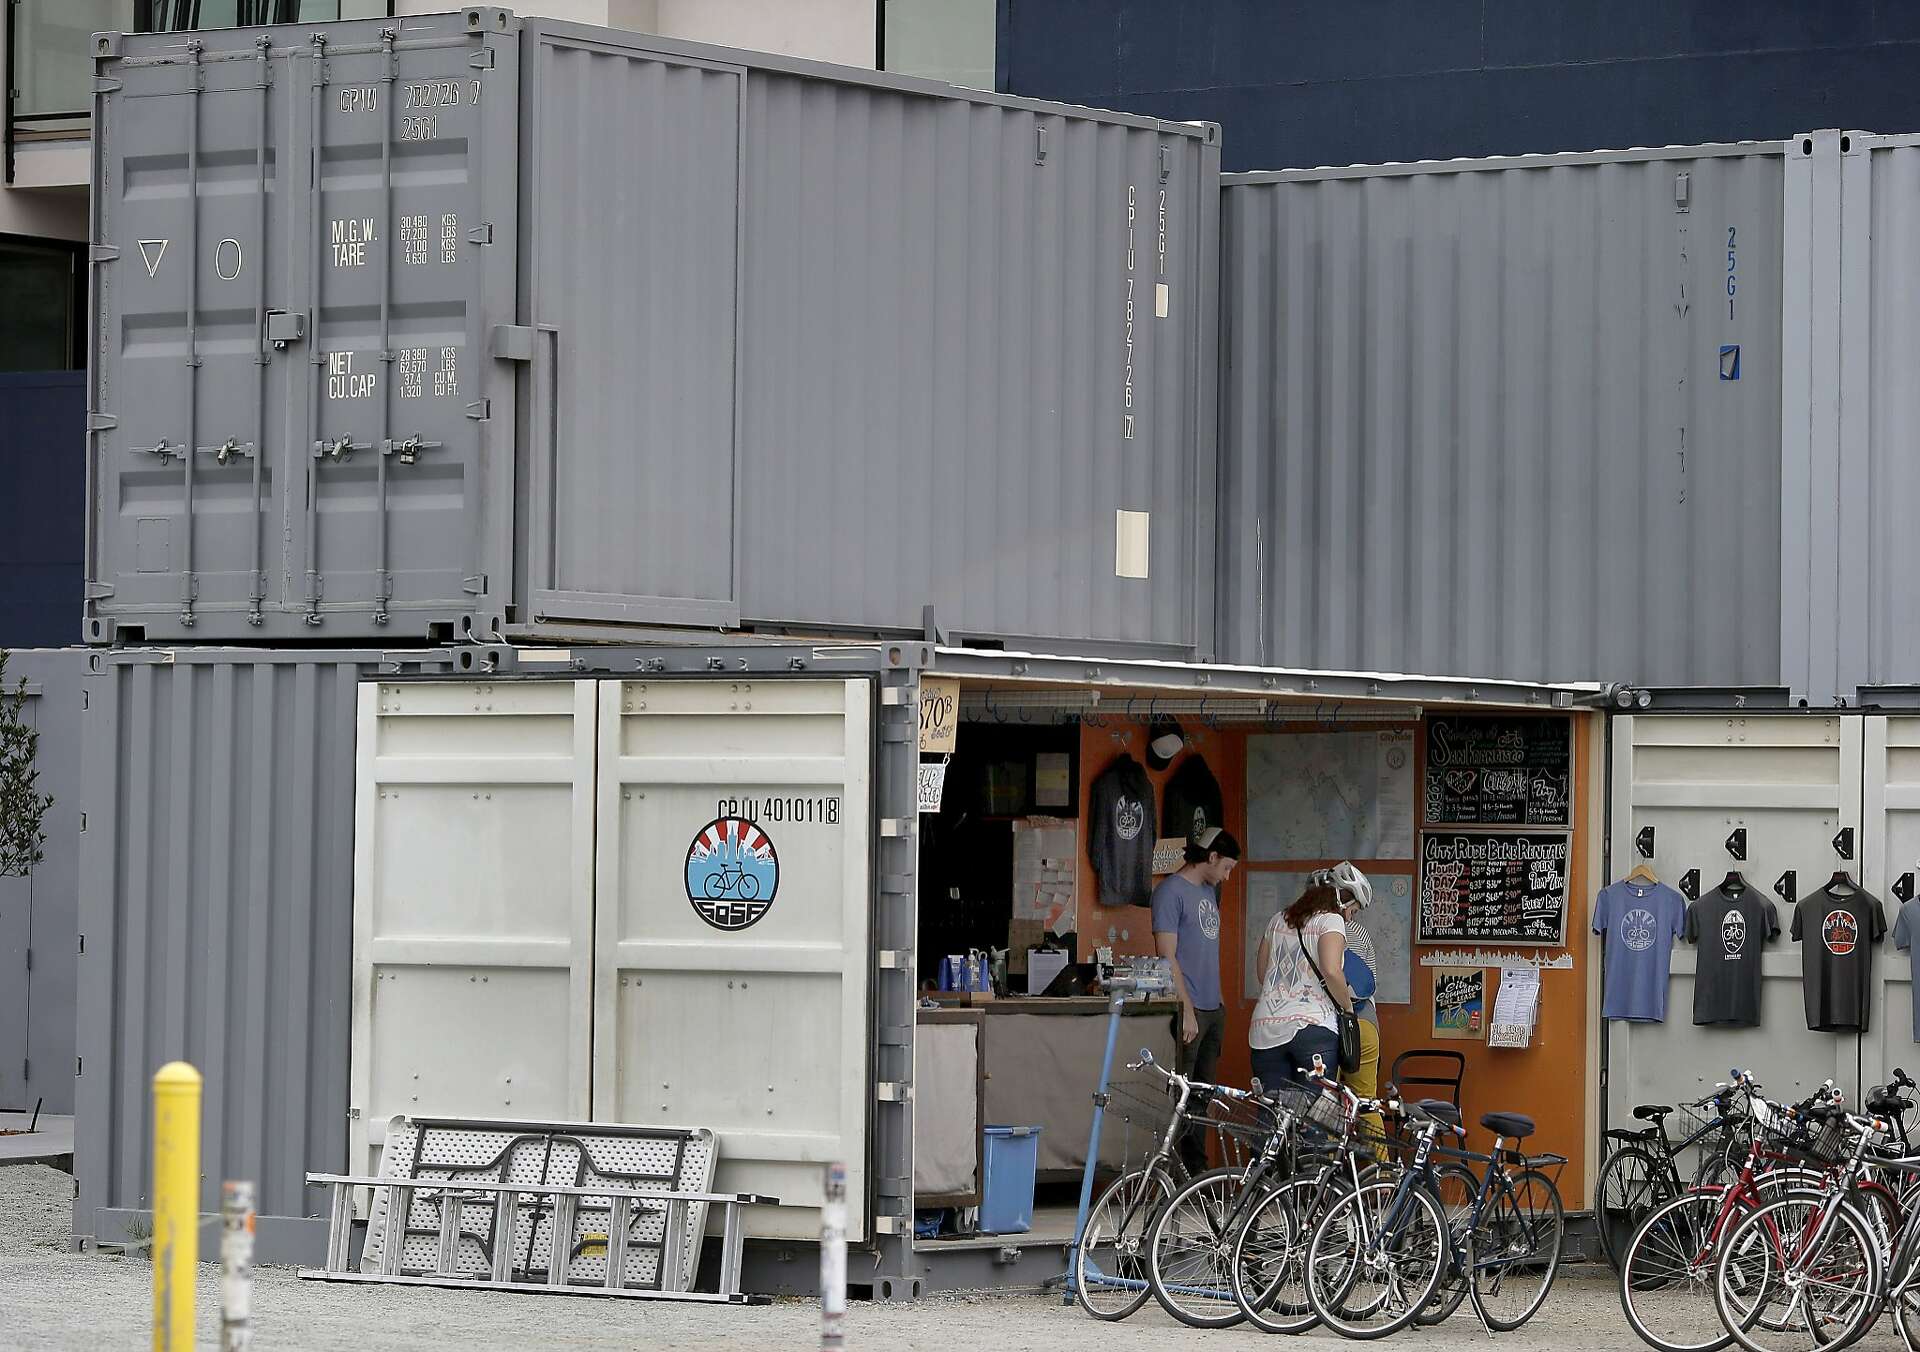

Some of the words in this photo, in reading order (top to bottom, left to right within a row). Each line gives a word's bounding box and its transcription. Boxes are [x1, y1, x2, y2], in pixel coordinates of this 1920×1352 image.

[401, 115, 438, 140] 25G1
[332, 218, 378, 243] M.G.W.
[441, 214, 457, 226] KGS
[441, 226, 457, 239] LBS
[332, 243, 366, 267] TARE
[441, 239, 457, 251] KGS
[441, 251, 457, 264] LBS
[329, 351, 353, 375] NET
[441, 347, 456, 359] KGS
[441, 359, 456, 371] LBS
[329, 374, 376, 399] CU.CAP
[1454, 837, 1487, 860] RIDE
[1488, 838, 1518, 861] BIKE
[1432, 875, 1457, 890] DAY
[1432, 889, 1459, 904] DAYS
[1432, 903, 1459, 917] DAYS
